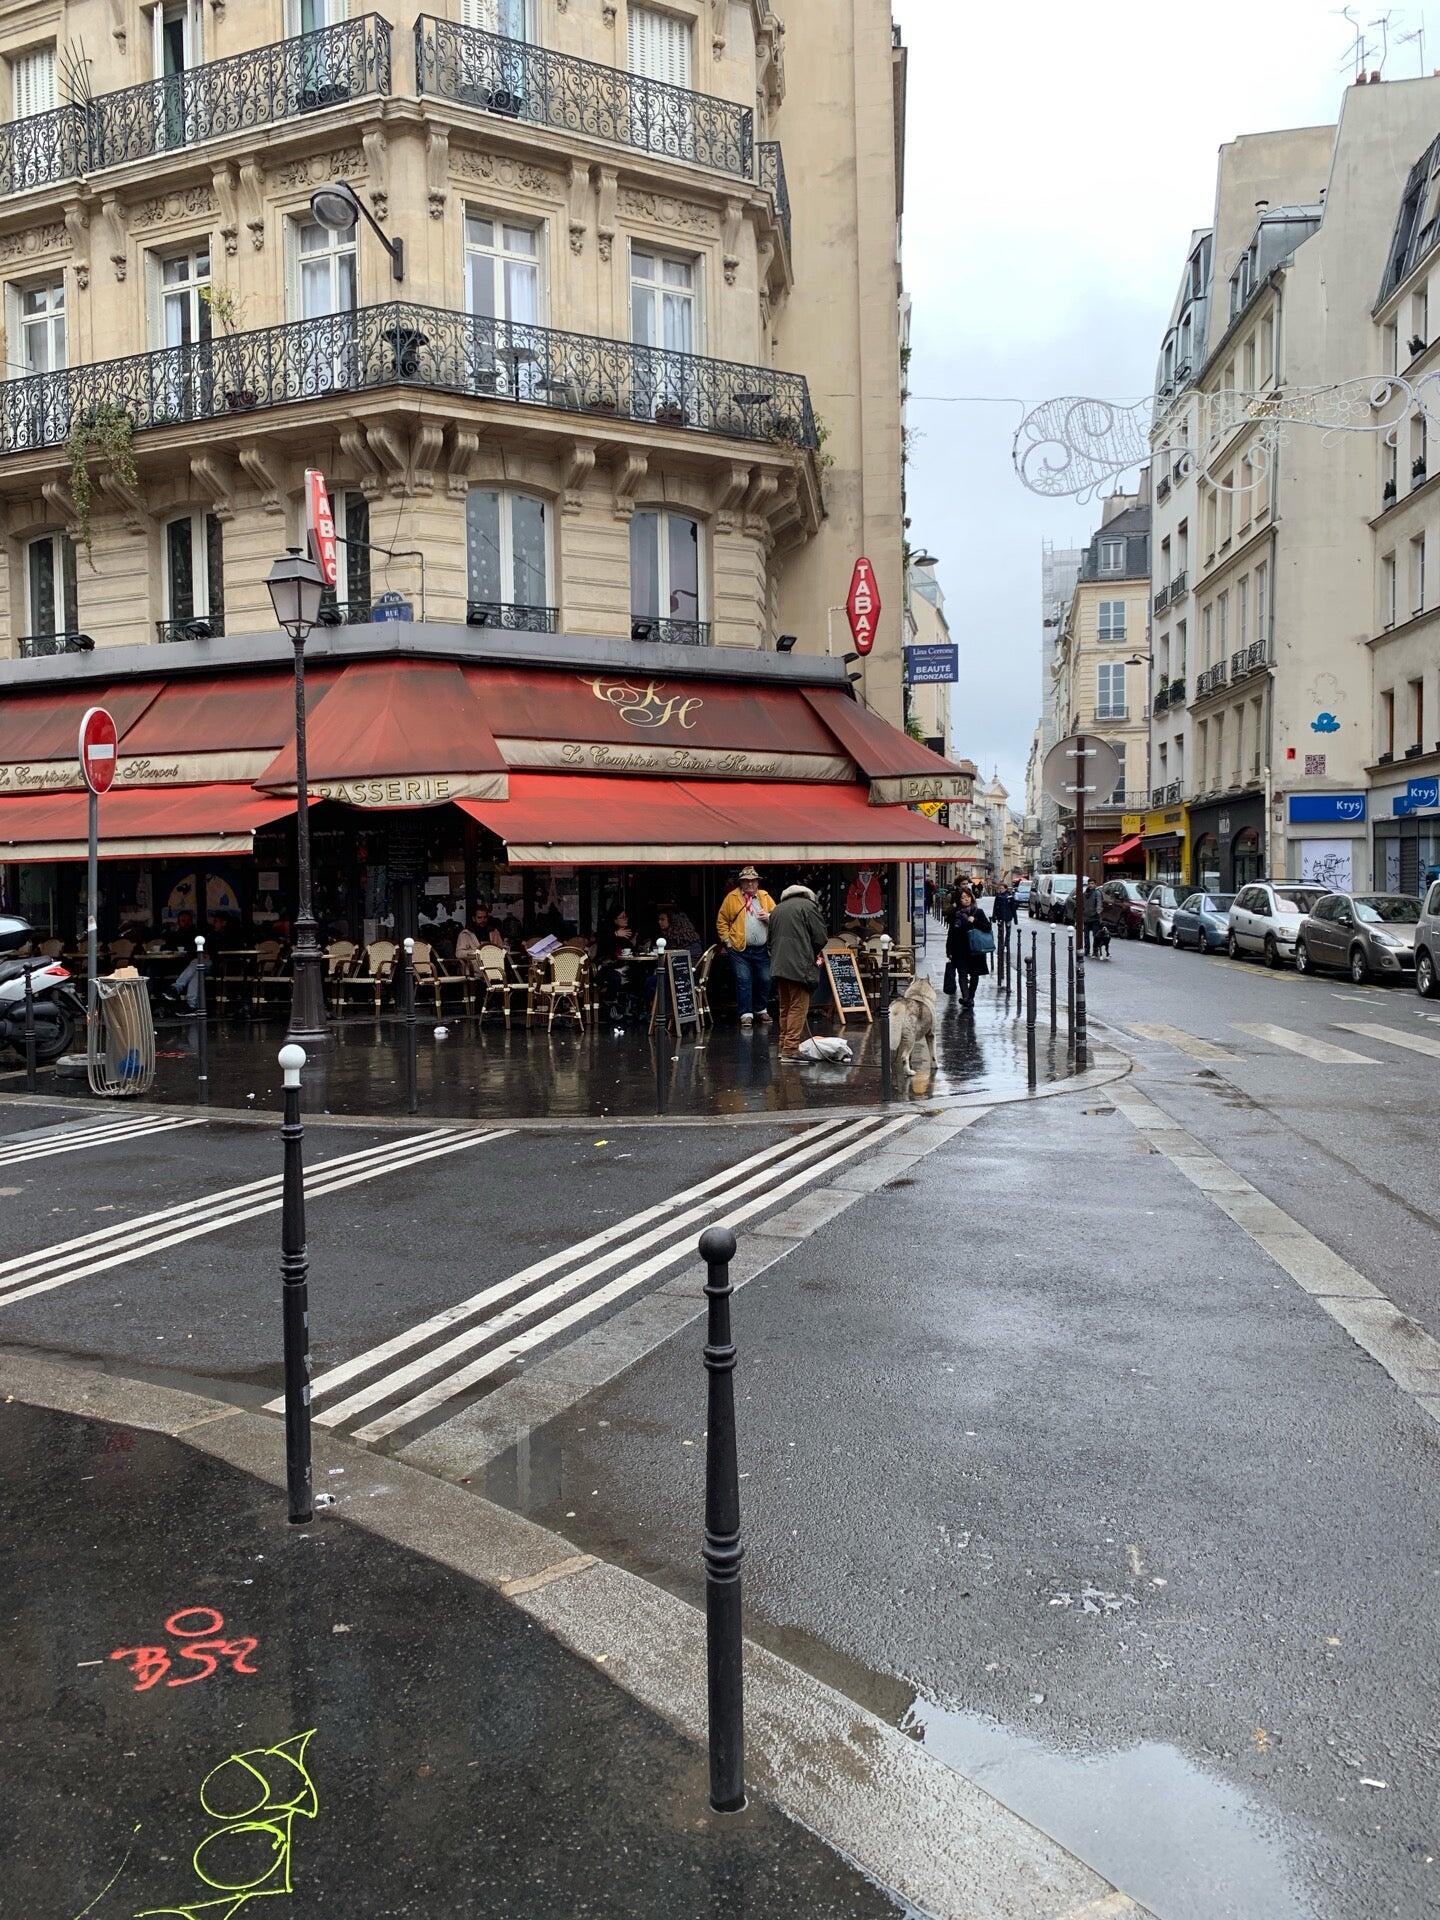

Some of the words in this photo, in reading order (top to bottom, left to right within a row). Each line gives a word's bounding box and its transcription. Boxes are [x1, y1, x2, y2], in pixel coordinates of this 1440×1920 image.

[315, 475, 337, 581] TABAC
[855, 565, 872, 646] TABAC
[913, 673, 954, 681] BRONZAGE
[915, 664, 952, 674] BEAUTÉ
[561, 744, 585, 765] Le
[589, 745, 659, 770] Comptoir
[15, 766, 71, 789] Comptoir
[907, 780, 943, 798] BAR
[1411, 787, 1435, 800] Krys
[926, 802, 939, 815] PRE
[940, 803, 948, 824] OTE
[1336, 800, 1360, 813] Krys
